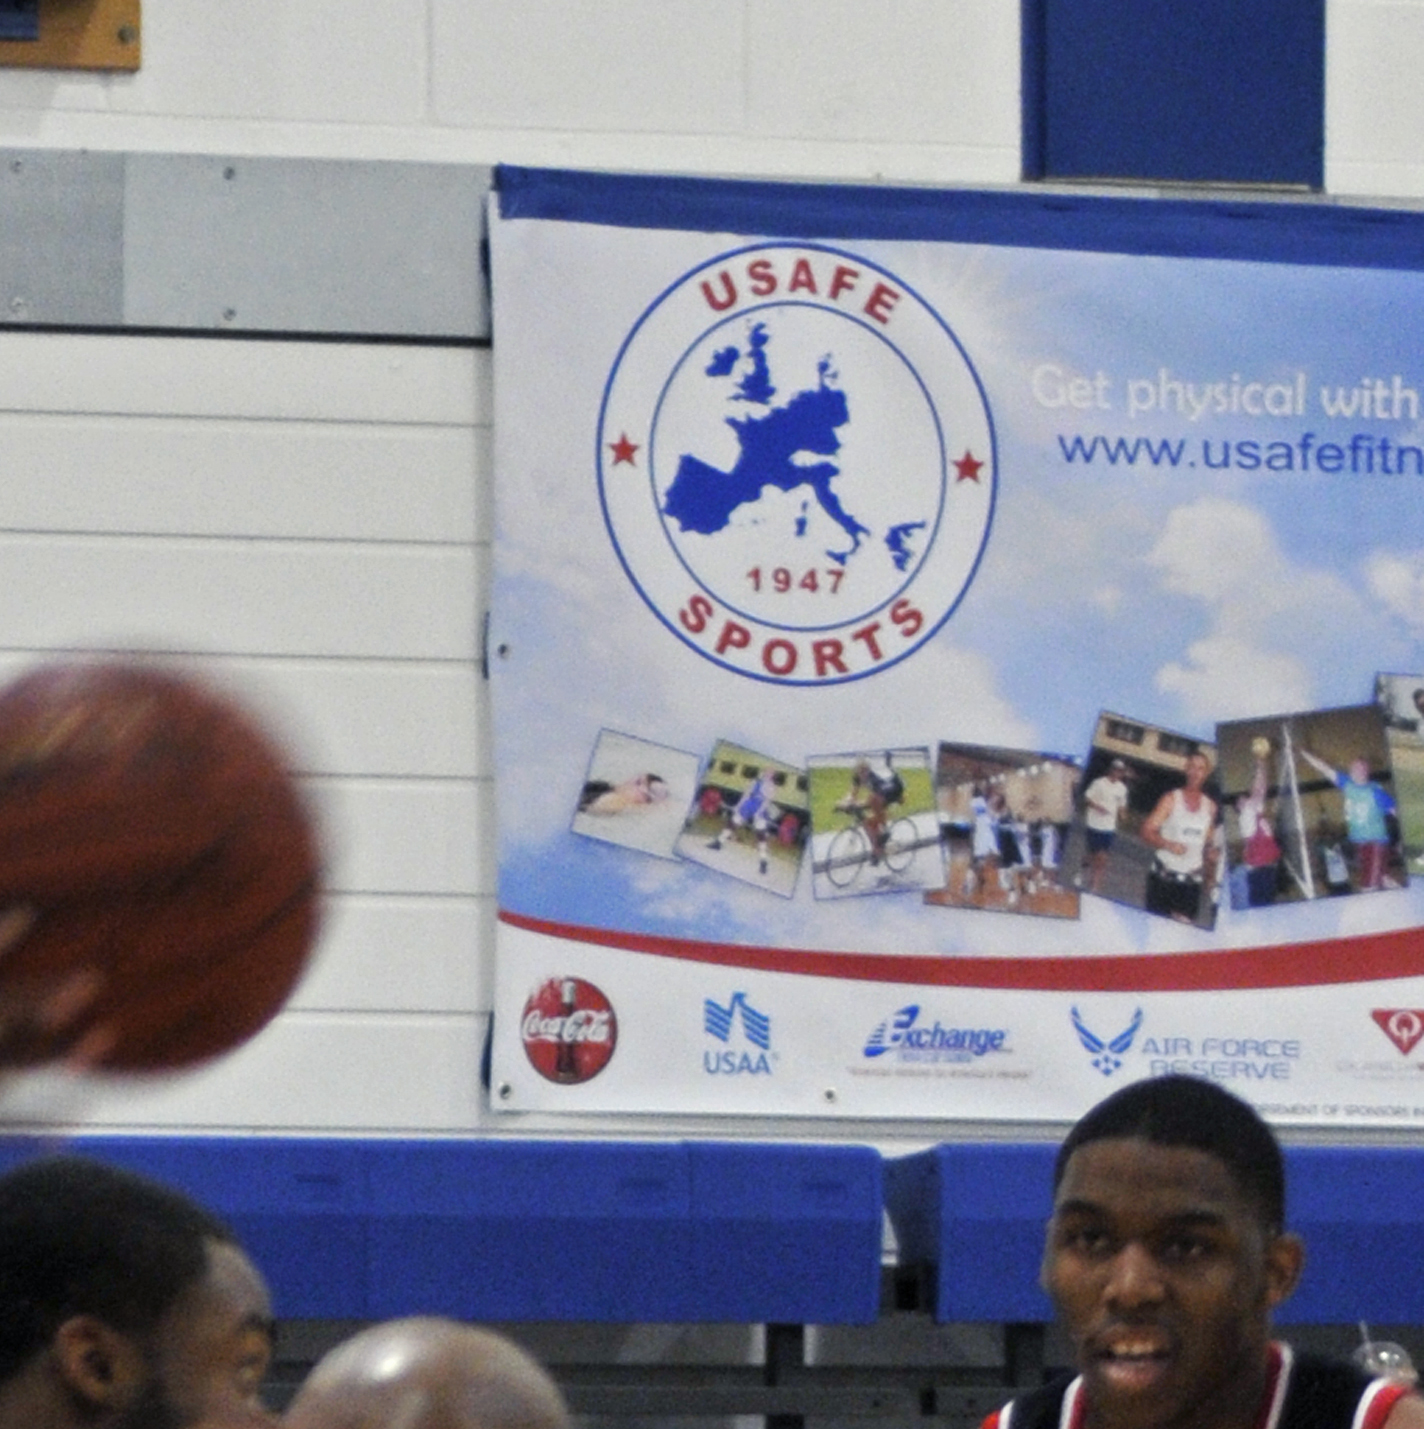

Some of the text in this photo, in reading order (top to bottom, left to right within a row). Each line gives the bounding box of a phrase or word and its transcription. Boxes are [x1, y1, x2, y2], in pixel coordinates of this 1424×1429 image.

[701, 258, 901, 325] USAFE
[1030, 363, 1421, 422] Get physical with
[1058, 431, 1424, 475] www.usafefitn
[746, 567, 846, 594] 1947
[678, 594, 925, 677] SPORTS
[704, 1051, 772, 1075] USAA
[1142, 1037, 1301, 1059] AIR FORCE
[1149, 1058, 1292, 1080] RESERVE
